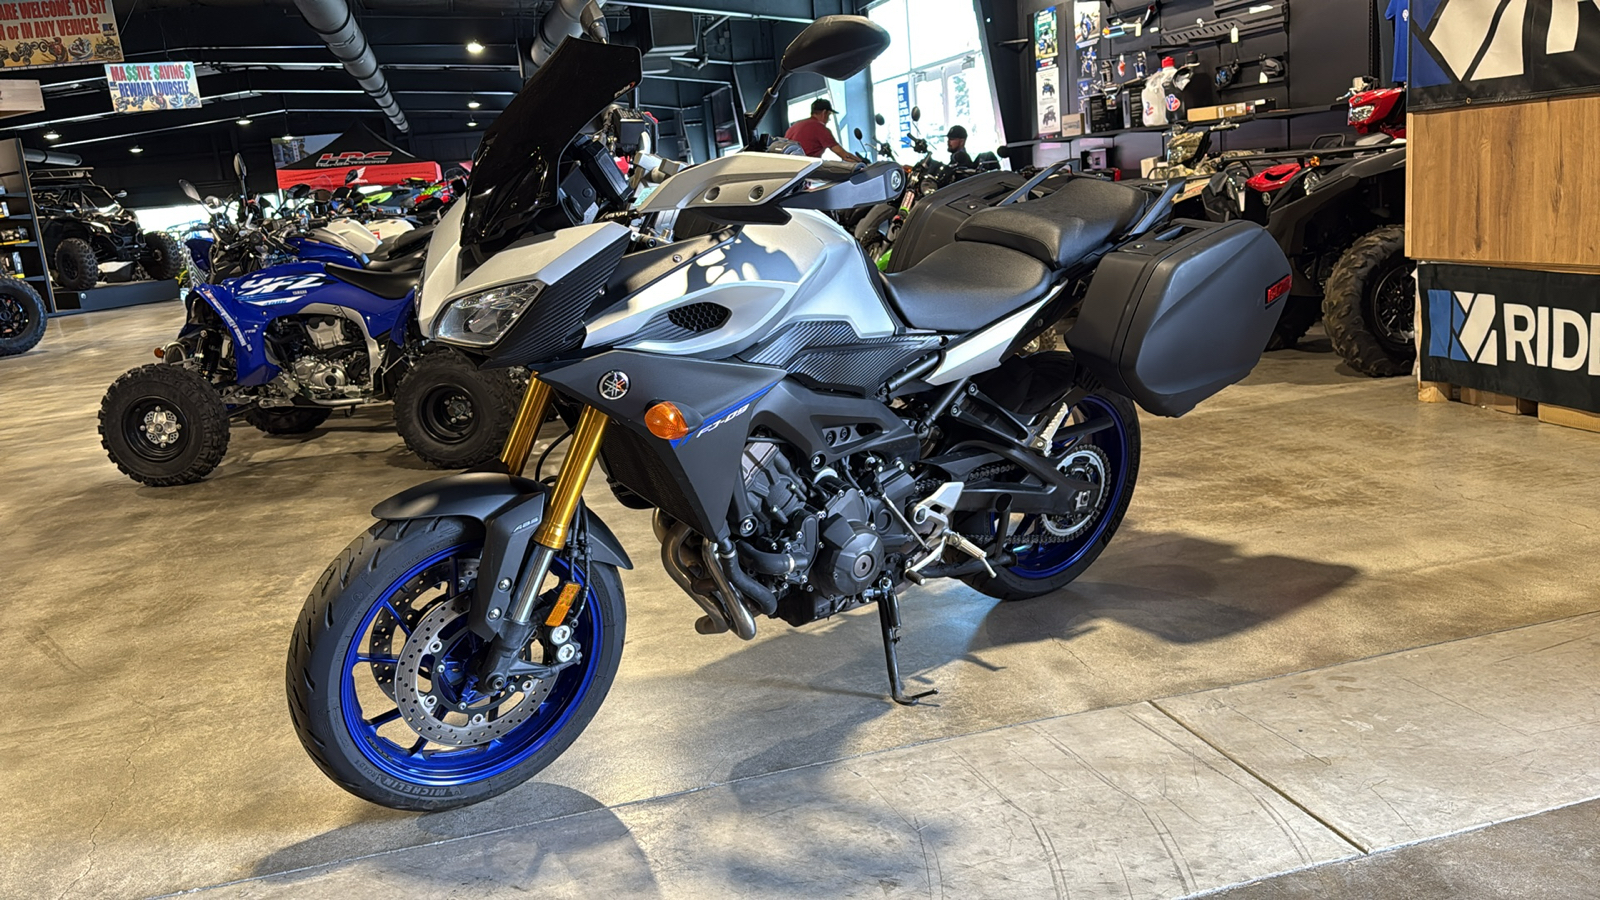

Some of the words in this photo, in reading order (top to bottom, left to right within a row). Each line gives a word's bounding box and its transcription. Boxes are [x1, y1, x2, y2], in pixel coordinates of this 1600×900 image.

[18, 0, 73, 19] WELCOME
[72, 0, 89, 15] TO
[6, 25, 19, 40] or
[20, 21, 34, 39] IN
[34, 19, 56, 38] ANY
[56, 17, 101, 36] VEHICLE
[118, 82, 154, 98] REWARD
[152, 81, 189, 96] YOURSELF
[315, 151, 393, 164] HRC
[237, 271, 327, 297] YFZ
[696, 403, 750, 438] FJ-09
[383, 777, 448, 797] MICHELIN
